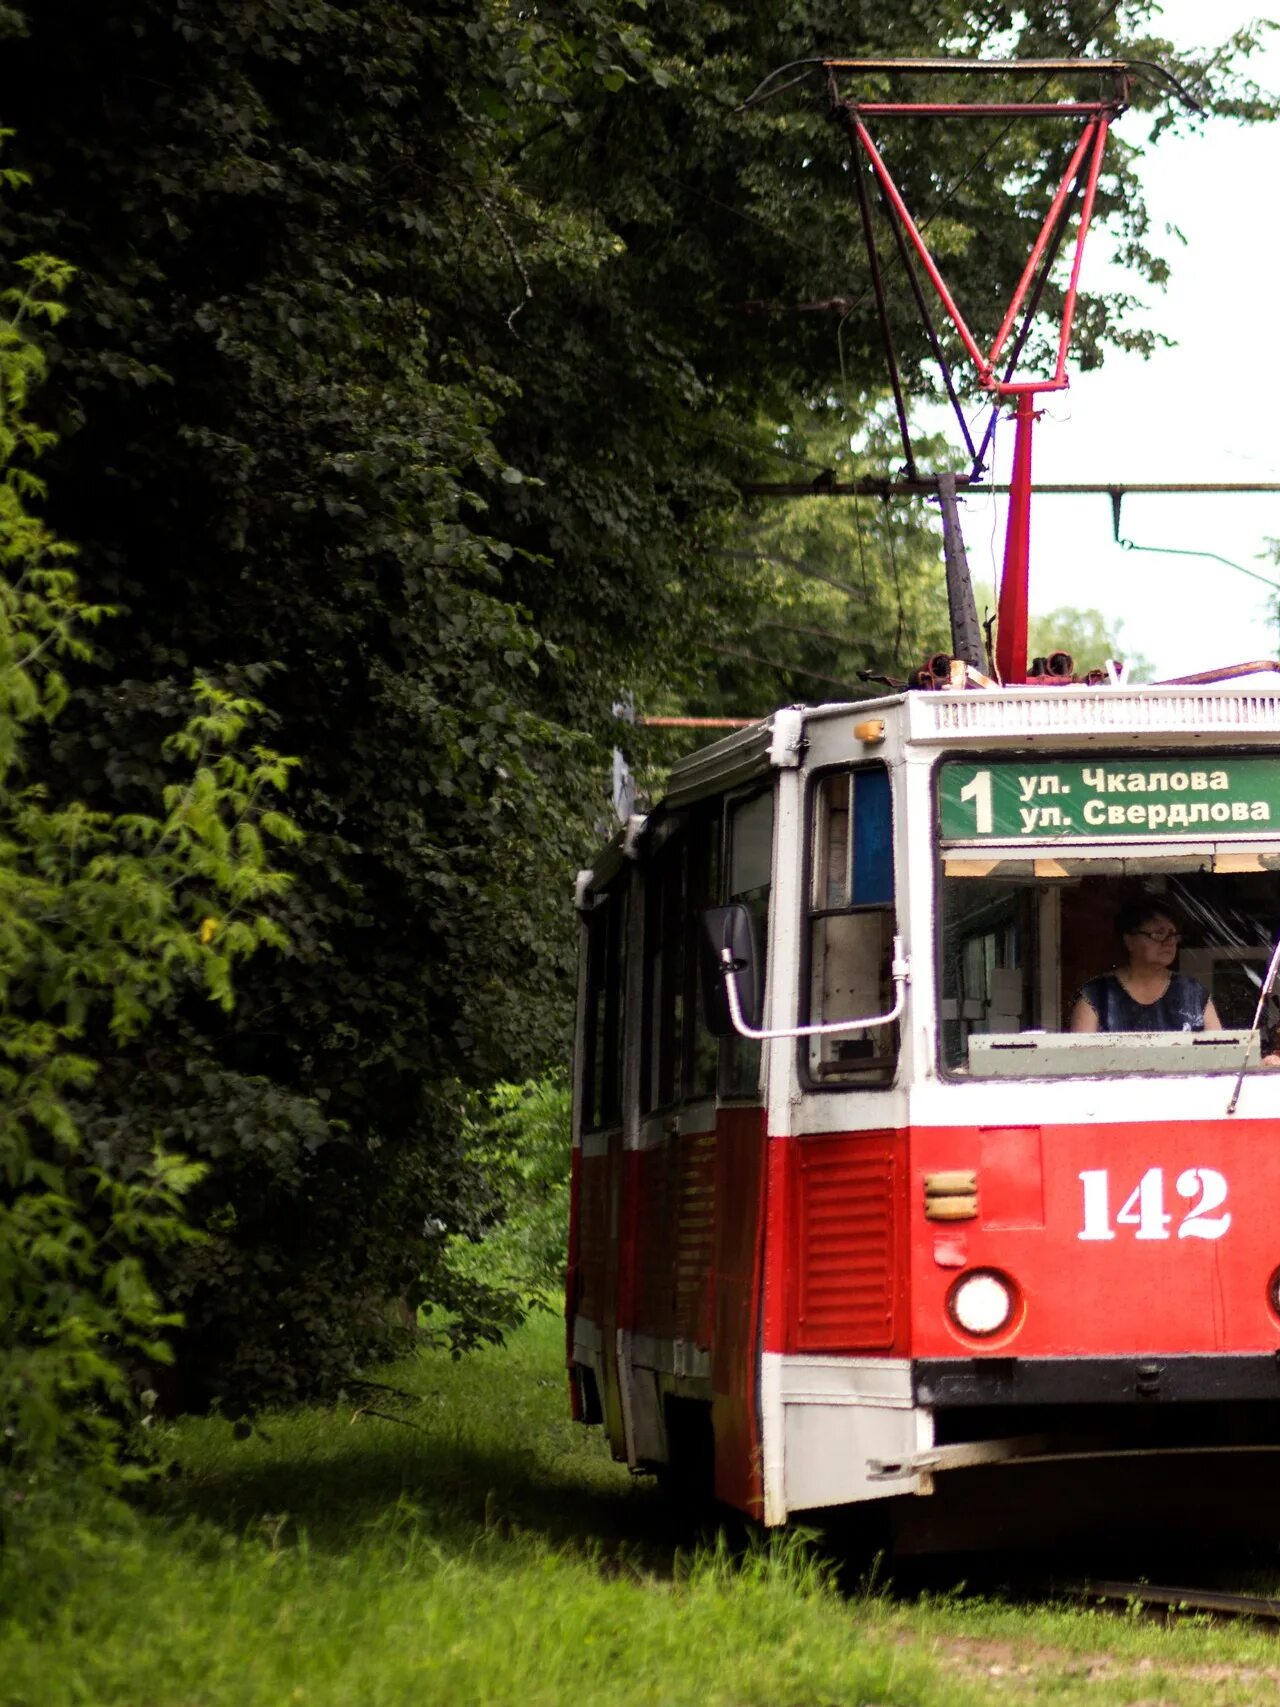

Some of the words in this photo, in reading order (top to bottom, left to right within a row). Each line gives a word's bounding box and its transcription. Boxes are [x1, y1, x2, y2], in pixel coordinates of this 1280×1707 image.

[960, 771, 994, 833] 1
[1018, 773, 1071, 801] ул.
[1082, 768, 1229, 793] Чкалова
[1020, 805, 1072, 833] ул.
[1083, 799, 1271, 829] Свердлова
[1077, 1167, 1232, 1240] 142
